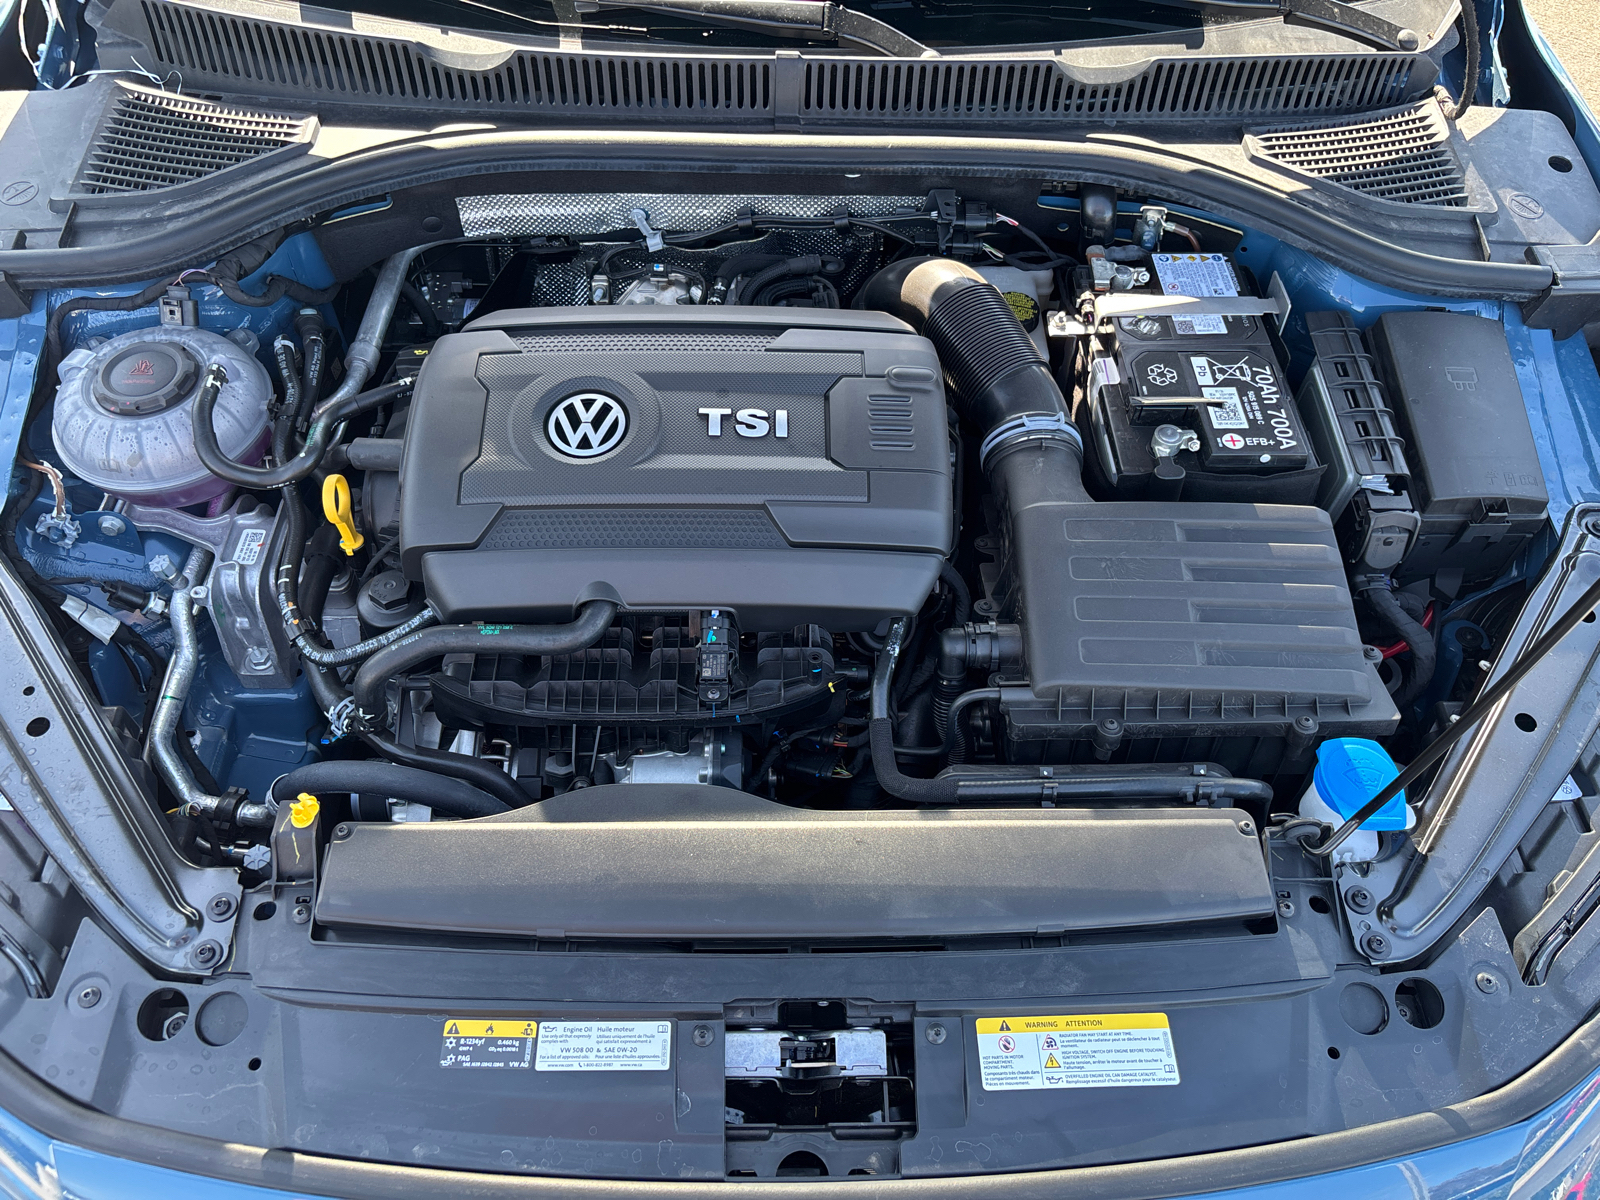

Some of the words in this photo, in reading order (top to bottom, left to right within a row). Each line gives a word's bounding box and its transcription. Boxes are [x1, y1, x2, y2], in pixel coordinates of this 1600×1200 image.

[1196, 366, 1208, 377] Pb
[1252, 366, 1280, 404] 70Ah
[1267, 408, 1297, 450] 700A
[698, 408, 788, 438] TSI
[1245, 438, 1276, 446] EFB+
